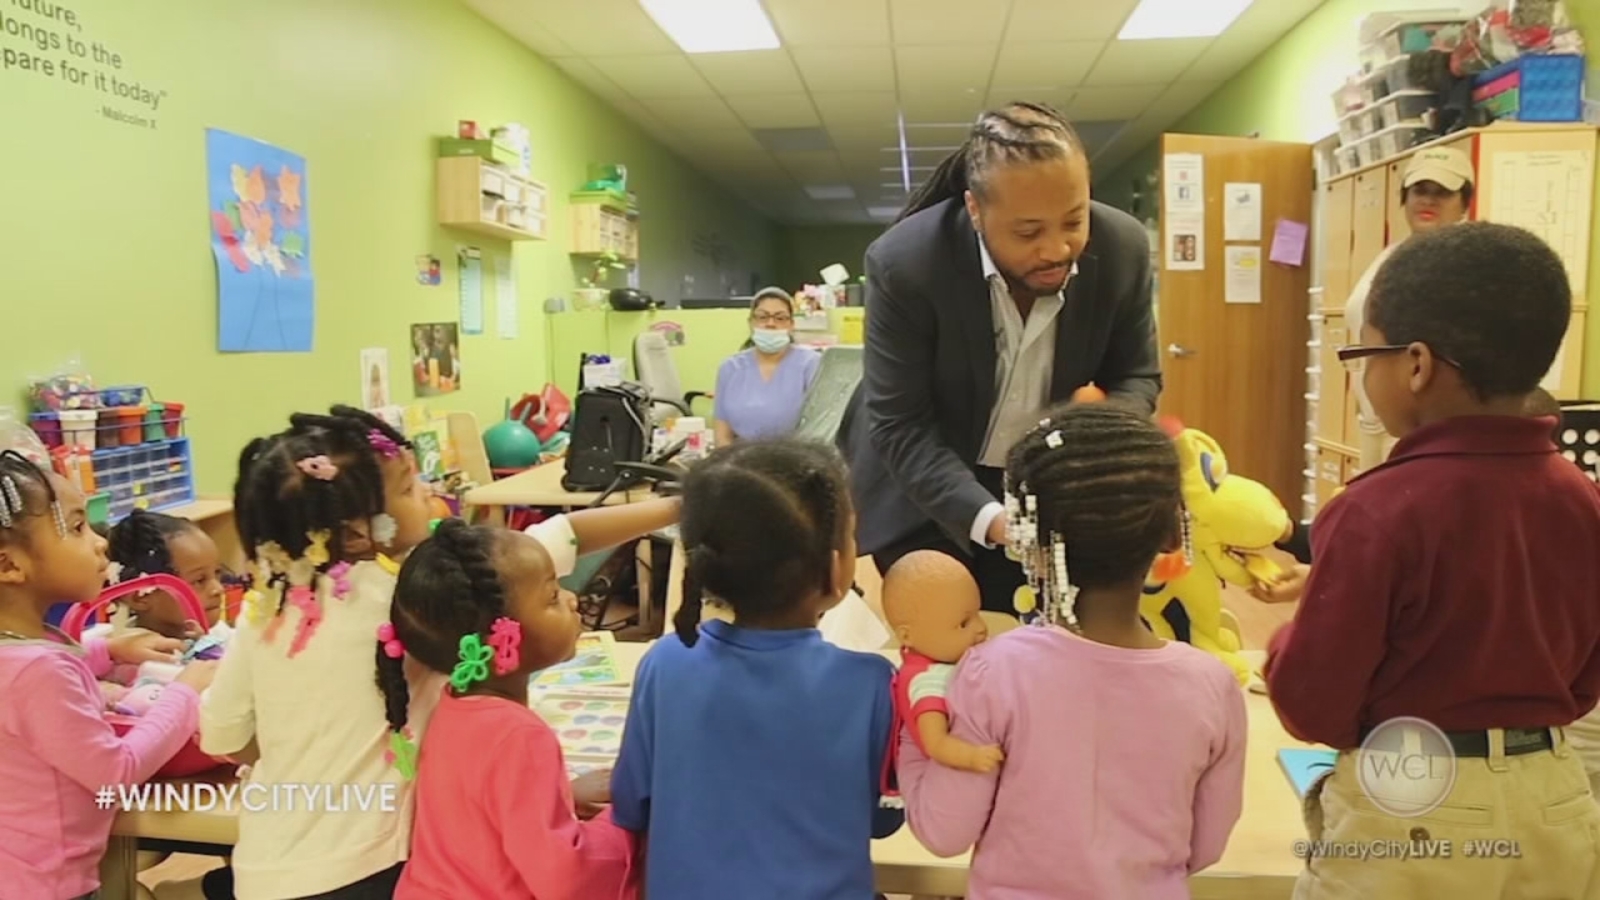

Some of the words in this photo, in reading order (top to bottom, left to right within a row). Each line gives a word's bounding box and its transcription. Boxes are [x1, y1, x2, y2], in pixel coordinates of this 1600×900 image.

[12, 0, 82, 32] uture,
[66, 33, 87, 58] to
[92, 42, 122, 69] the
[60, 59, 90, 85] for
[94, 69, 108, 93] it
[102, 104, 148, 128] Malcolm
